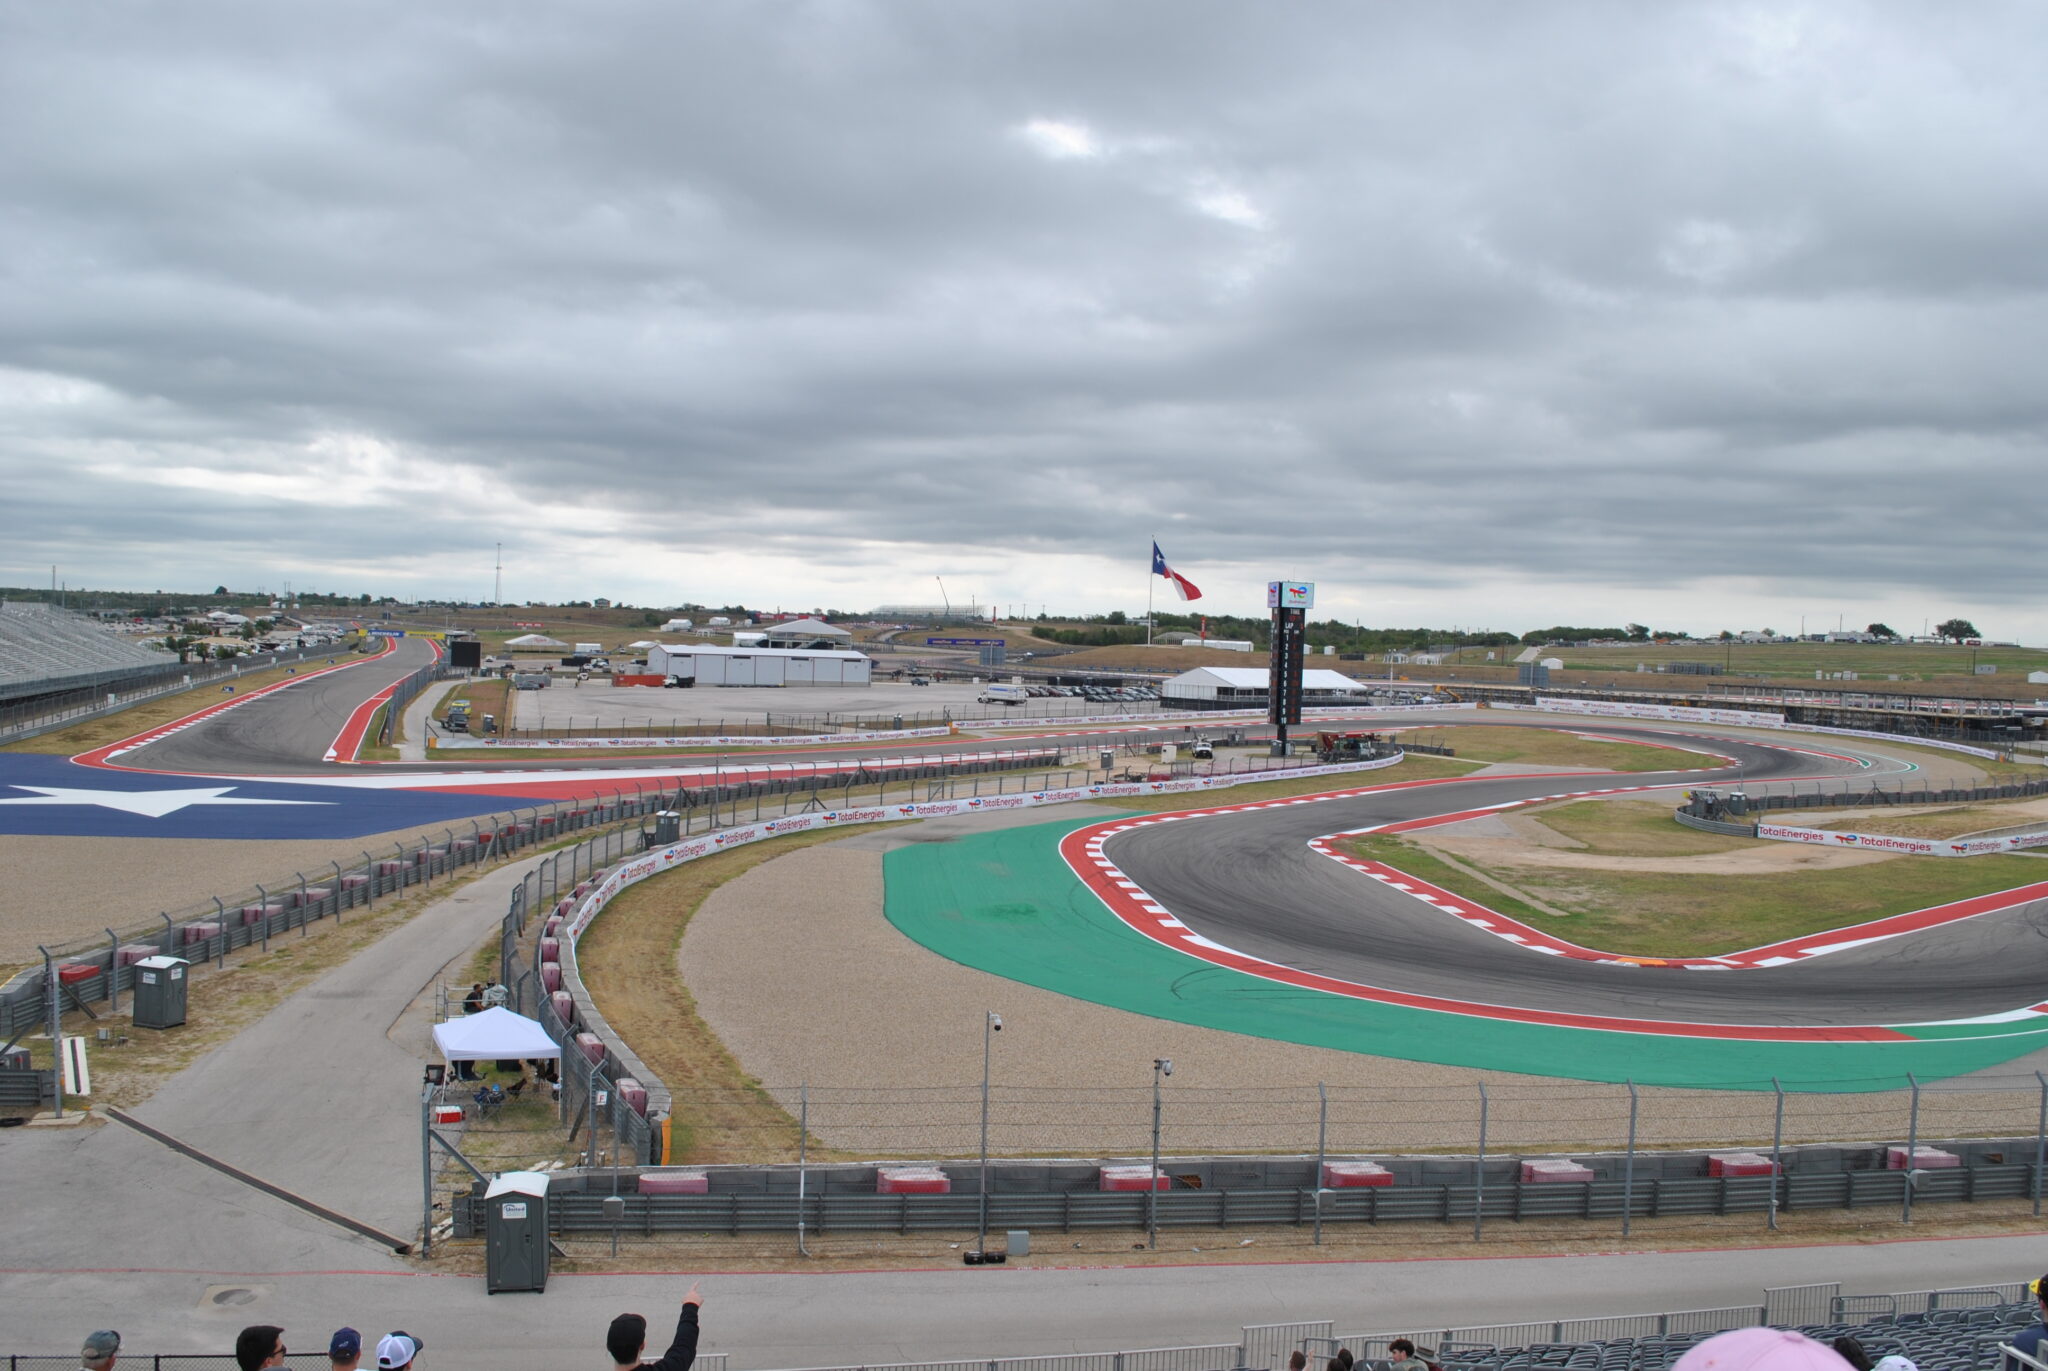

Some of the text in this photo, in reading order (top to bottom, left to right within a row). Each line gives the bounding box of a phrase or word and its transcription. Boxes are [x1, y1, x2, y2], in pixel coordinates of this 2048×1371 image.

[561, 739, 600, 747] TotalEnergies
[1101, 785, 1141, 795] TotalEnergies
[1164, 781, 1196, 791] TotalEnergies
[982, 796, 1024, 808] TotalEnergies
[1045, 790, 1080, 801] TotalEnergies
[838, 808, 885, 821] TotalEnergies
[916, 803, 958, 816] TotalEnergies
[776, 816, 811, 831] TotalEnergies
[724, 829, 756, 846] TotalEnergies
[1759, 825, 1824, 842] TotalEnergies
[1859, 835, 1931, 852] TotalEnergies
[1968, 840, 2002, 851] TotalEnergies
[674, 842, 707, 860] TotalEnergies
